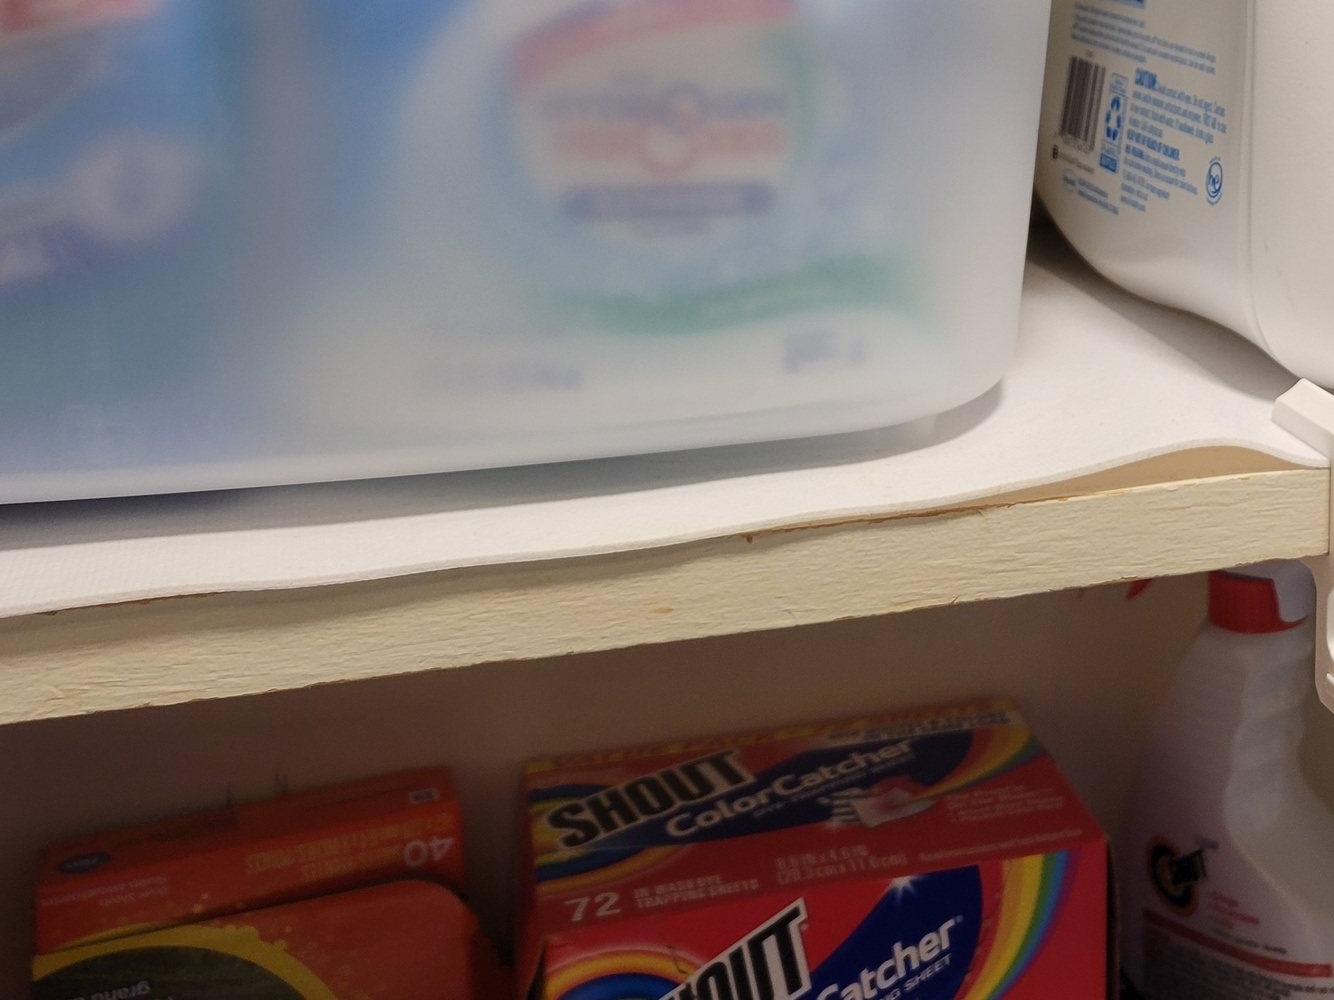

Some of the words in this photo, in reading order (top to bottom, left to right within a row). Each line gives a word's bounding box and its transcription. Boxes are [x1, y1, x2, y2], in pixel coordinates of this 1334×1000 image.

[547, 751, 749, 848] SHOUT
[665, 738, 913, 838] ColorCatcher
[403, 836, 455, 869] 40
[564, 891, 623, 922] 72
[903, 953, 952, 994] SHEET
